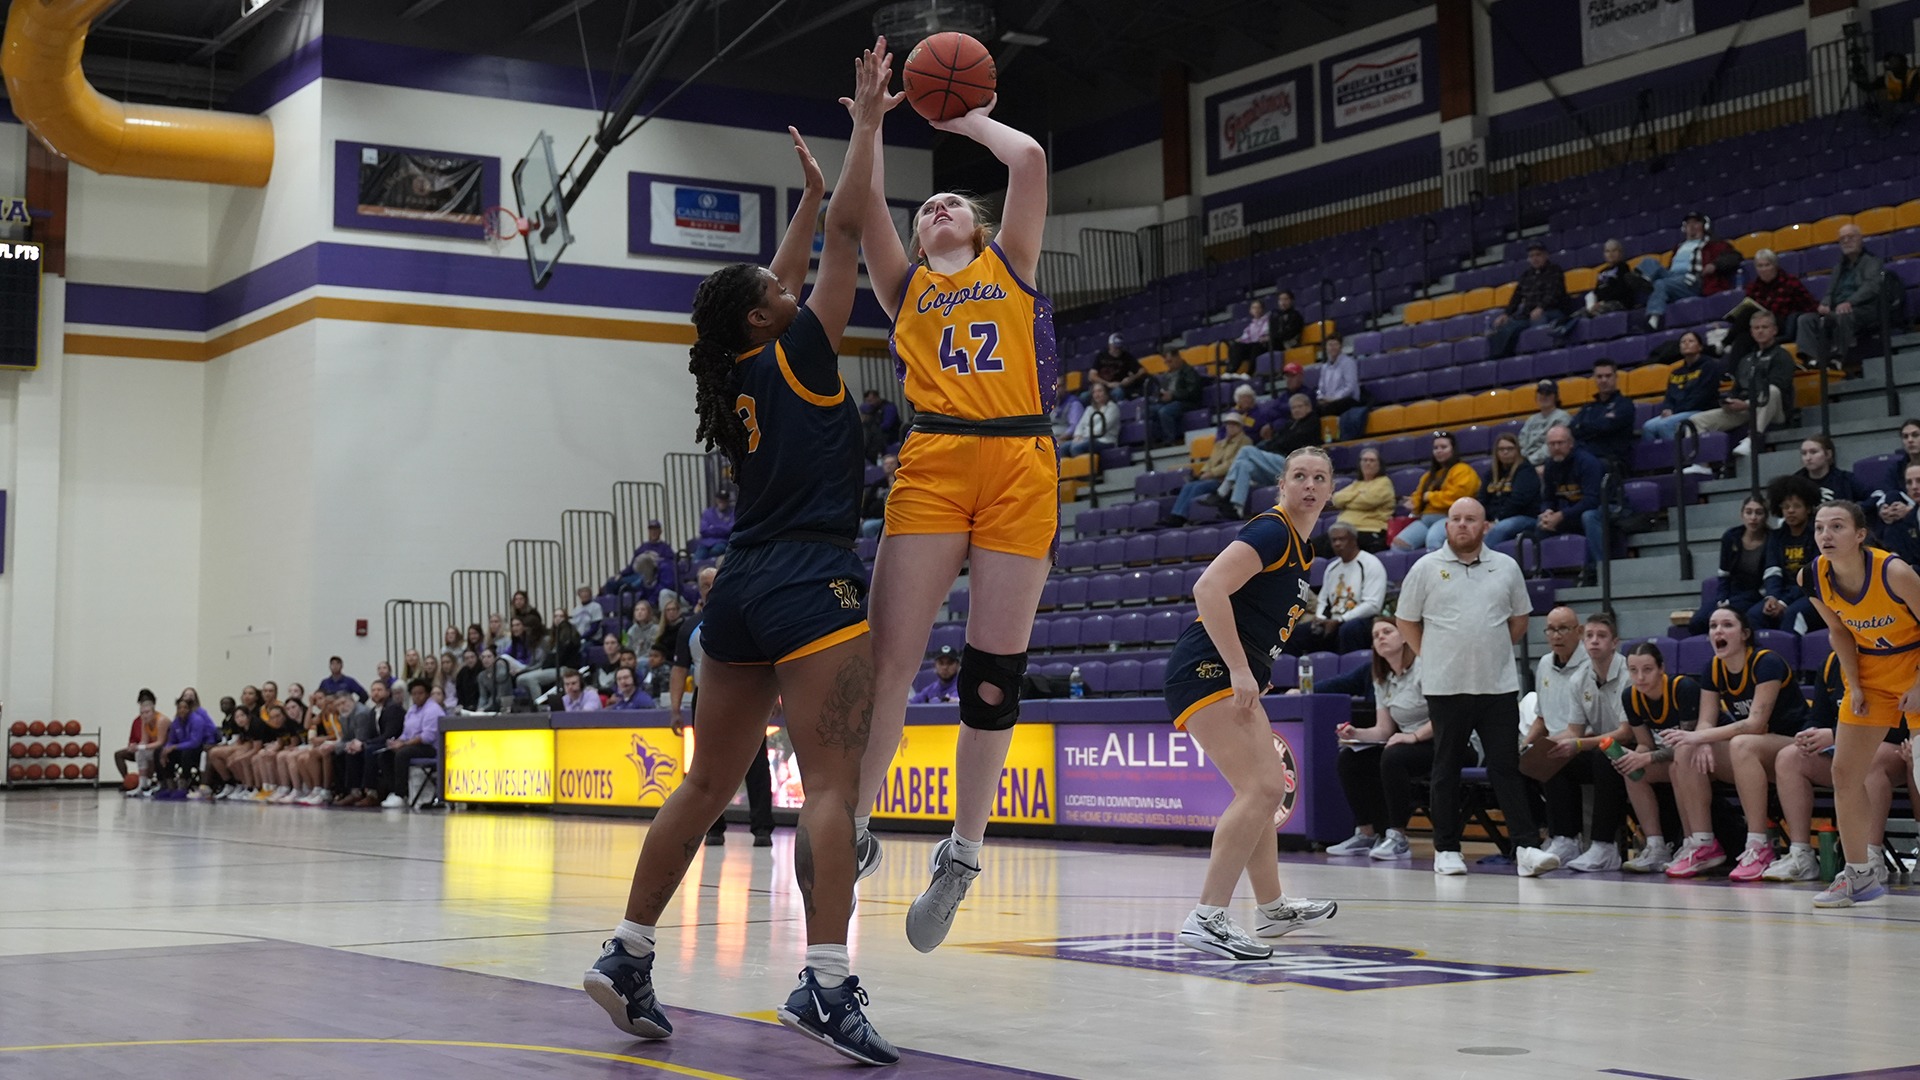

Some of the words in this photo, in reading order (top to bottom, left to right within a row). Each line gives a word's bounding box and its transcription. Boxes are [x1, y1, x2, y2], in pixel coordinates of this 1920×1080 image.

[1236, 125, 1279, 153] Pizza
[1447, 144, 1479, 170] 106
[1212, 208, 1239, 231] 105
[15, 244, 40, 261] PTS
[917, 280, 1007, 317] Coyotes
[938, 321, 1005, 375] 42
[1064, 746, 1099, 767] THE
[1100, 732, 1206, 768] ALLEY
[447, 769, 489, 795] KANSAS
[493, 769, 551, 797] WESLEYAN
[558, 769, 613, 799] COYOTES
[990, 767, 1050, 819] ENA
[1064, 794, 1097, 807] LOCATED
[1097, 795, 1105, 807] IN
[1106, 796, 1154, 809] DOWNTOWN
[1155, 797, 1183, 810] SALINA
[1065, 810, 1079, 822] THE
[1079, 811, 1101, 823] HOME
[1114, 812, 1145, 824] KANSAS
[1145, 813, 1187, 826] WESLEYAN
